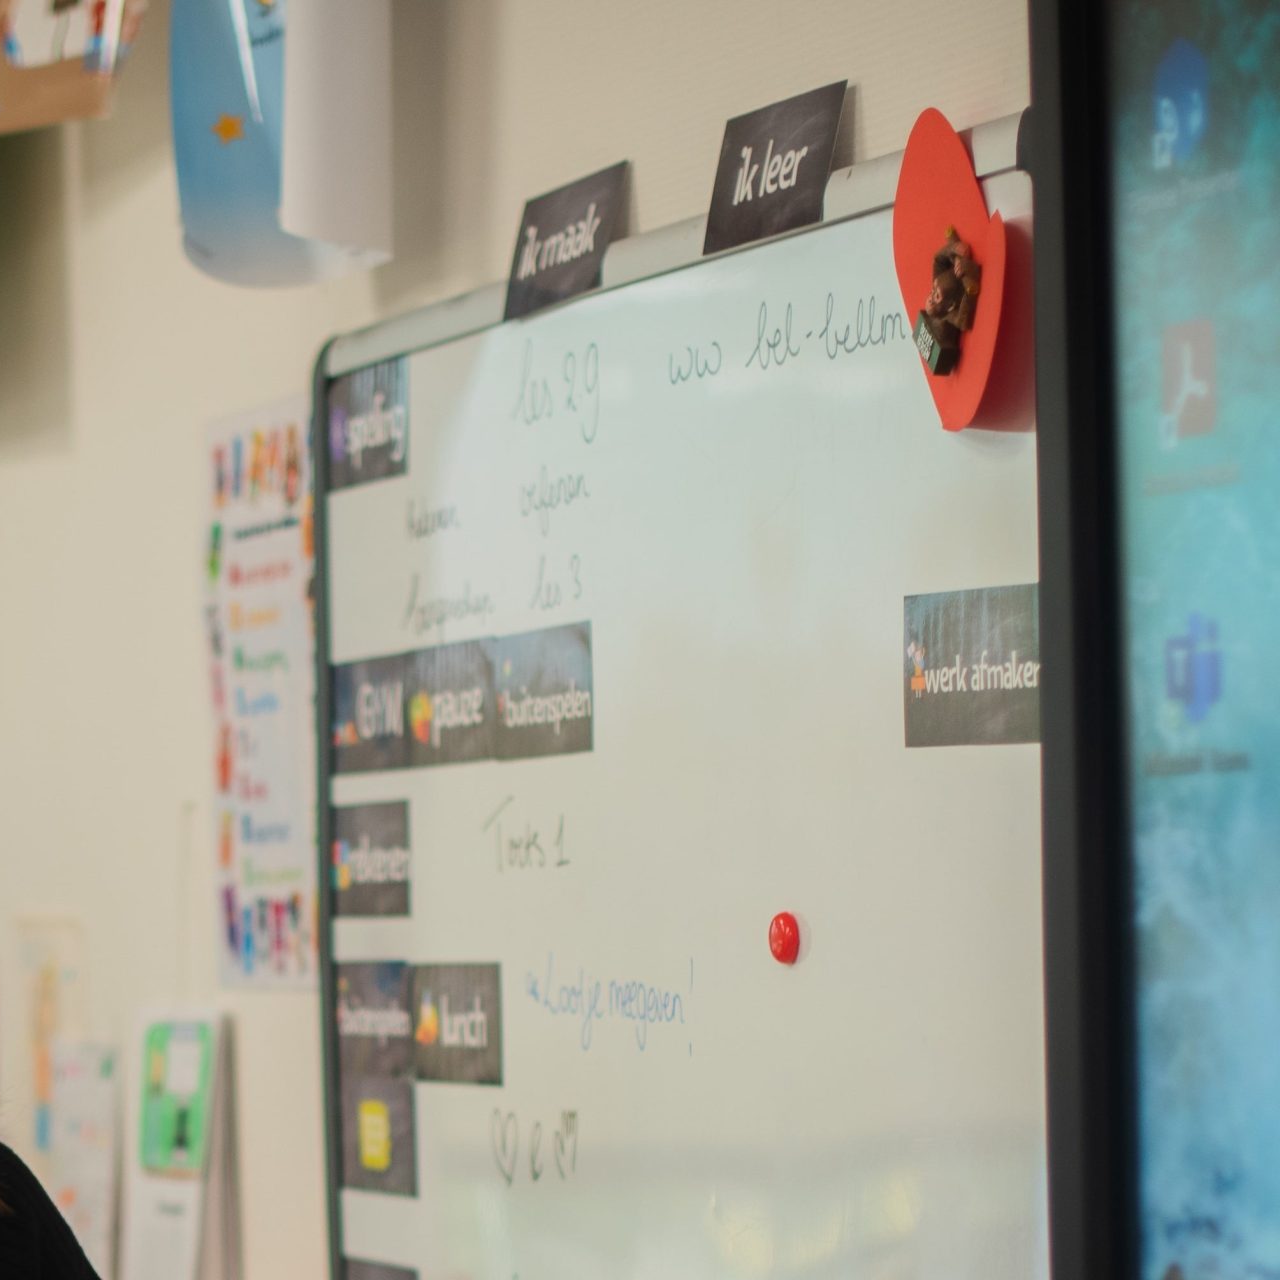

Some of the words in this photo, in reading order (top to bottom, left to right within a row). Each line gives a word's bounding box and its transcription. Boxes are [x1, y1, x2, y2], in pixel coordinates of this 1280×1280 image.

[732, 145, 758, 206] ik
[759, 138, 809, 199] leer
[517, 225, 539, 280] ik
[540, 202, 601, 270] maak
[925, 654, 968, 694] werk
[433, 686, 484, 748] pauze
[504, 677, 592, 736] buitenspelen
[440, 991, 488, 1047] lunch
